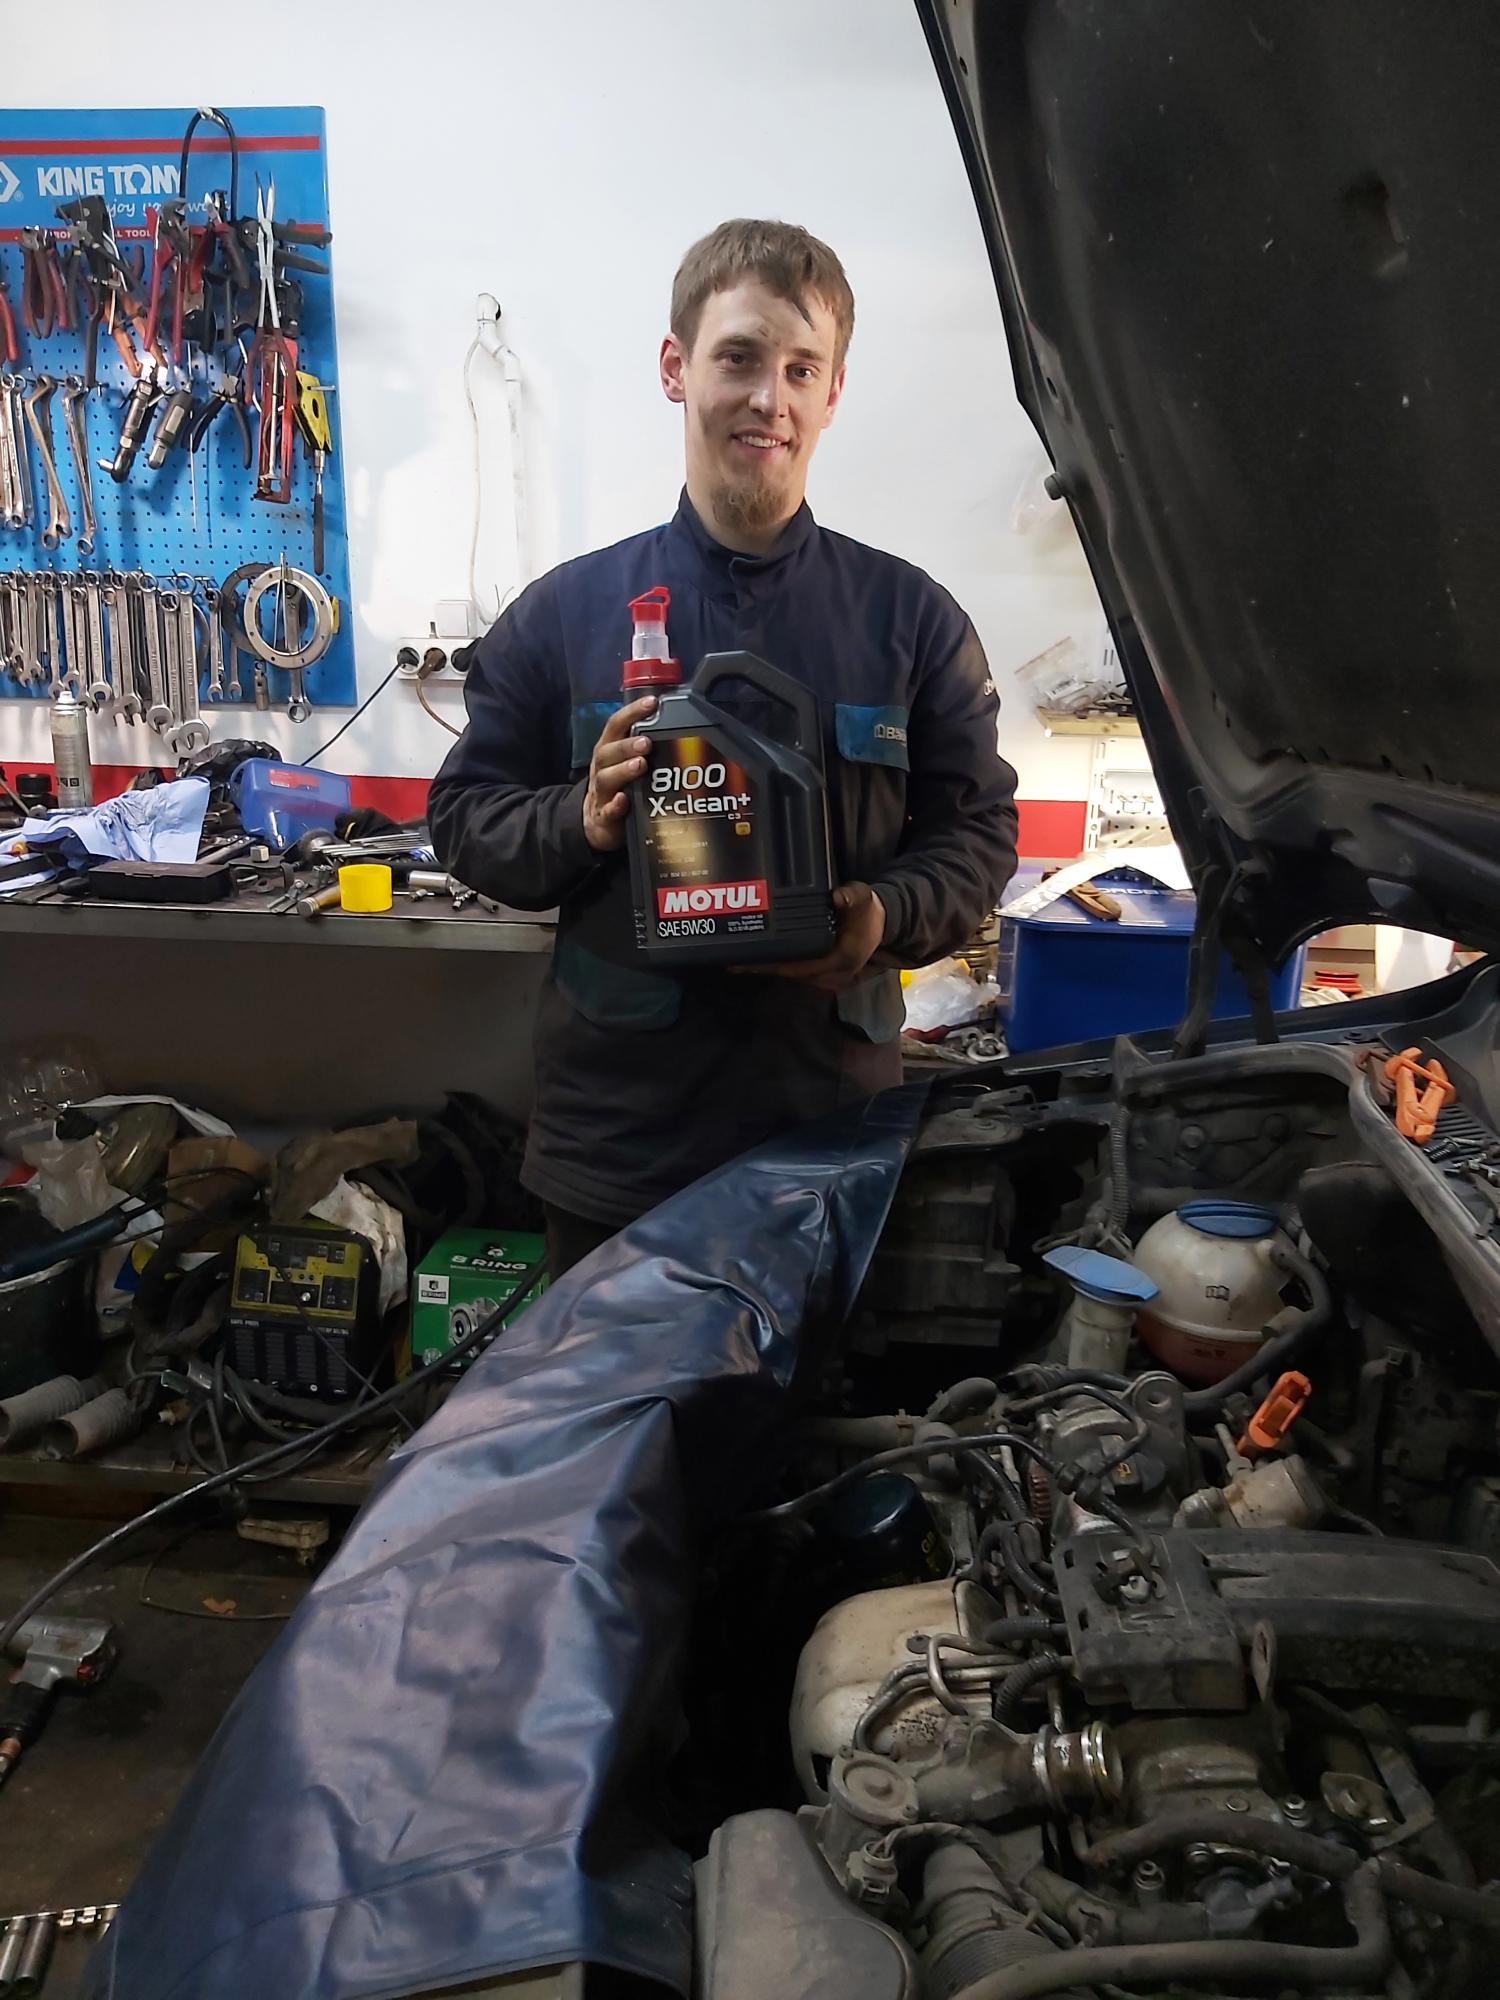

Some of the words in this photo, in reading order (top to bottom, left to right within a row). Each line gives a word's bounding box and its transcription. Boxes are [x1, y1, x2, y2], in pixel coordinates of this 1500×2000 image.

[37, 165, 104, 197] KING
[108, 163, 187, 196] TONY
[106, 198, 136, 218] joy
[651, 763, 726, 793] 8100
[648, 792, 752, 818] X-clean+
[664, 886, 761, 913] MOTUL
[471, 1258, 527, 1270] RING
